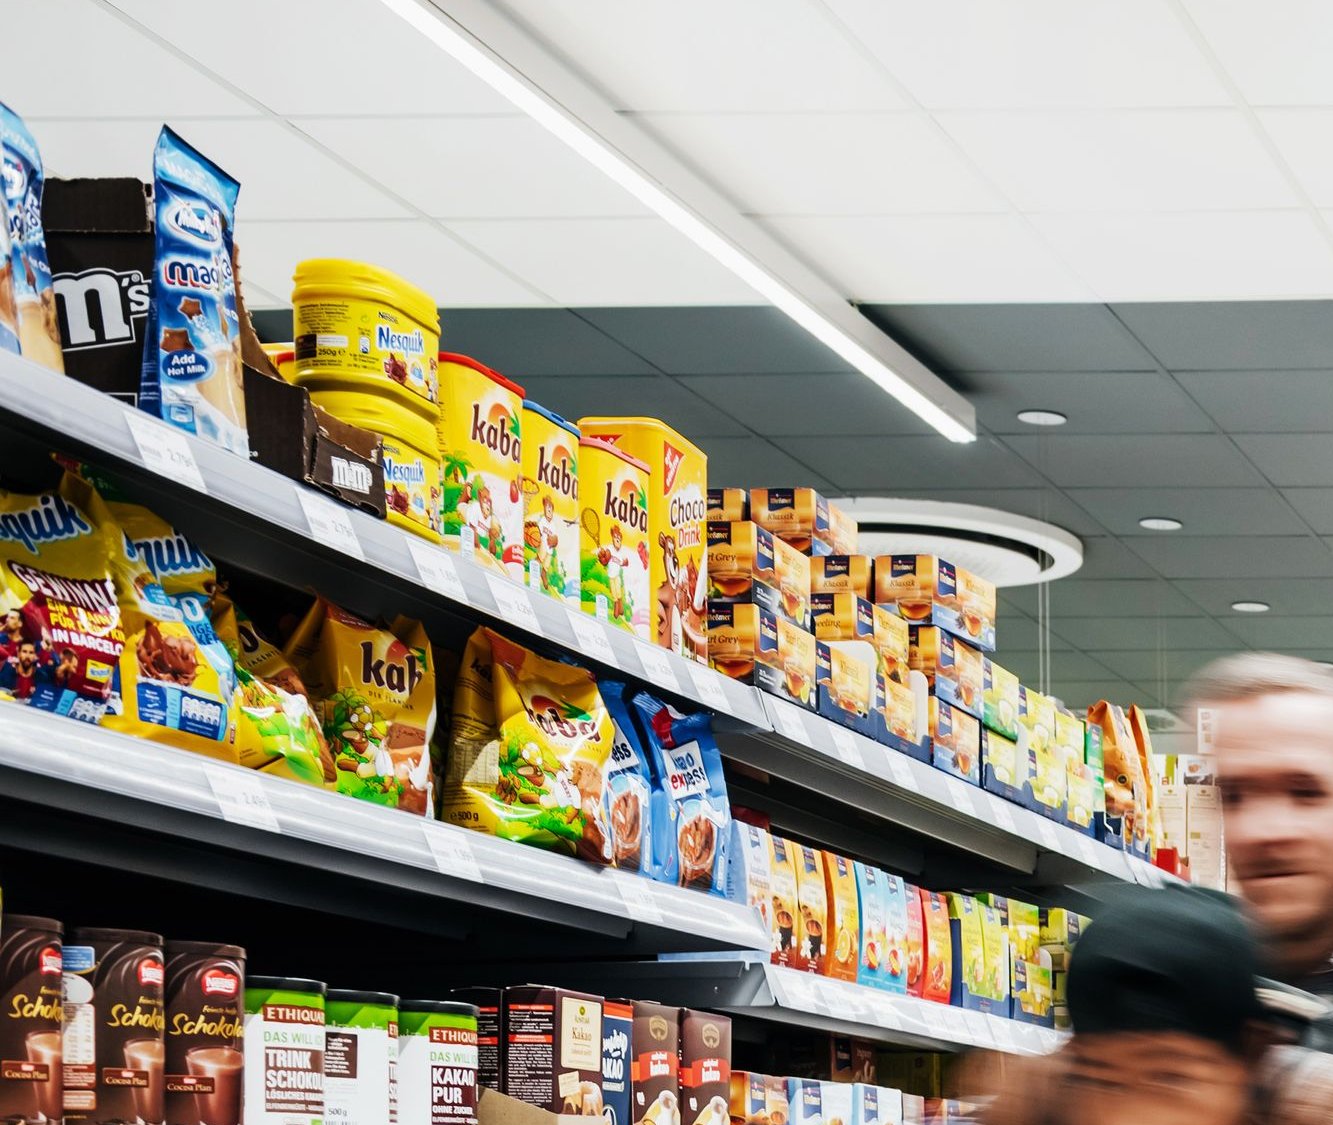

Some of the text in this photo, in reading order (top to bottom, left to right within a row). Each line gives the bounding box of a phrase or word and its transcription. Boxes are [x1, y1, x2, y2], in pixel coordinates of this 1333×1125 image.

[378, 325, 424, 358] Nesquik
[171, 354, 195, 365] Add
[167, 367, 186, 377] Hot
[472, 403, 521, 464] kaba
[605, 482, 648, 534] kaba
[670, 496, 704, 528] Choco
[678, 528, 701, 550] Drink
[715, 552, 736, 564] Grey
[52, 627, 68, 643] IN
[718, 634, 739, 647] Grey
[264, 1031, 288, 1043] DAS
[571, 1027, 592, 1042] Kakao
[266, 1049, 311, 1068] TRINK
[430, 1051, 450, 1062] DAS
[5, 1070, 47, 1080] Cocoa Plan
[603, 1058, 624, 1080] AKAO
[106, 1076, 147, 1086] Cocoa Plan
[432, 1067, 475, 1086] KAKAO
[167, 1082, 212, 1092] Cocoa Plan
[432, 1087, 463, 1104] PUR
[328, 1108, 341, 1116] 500
[432, 1105, 453, 1115] OHNE
